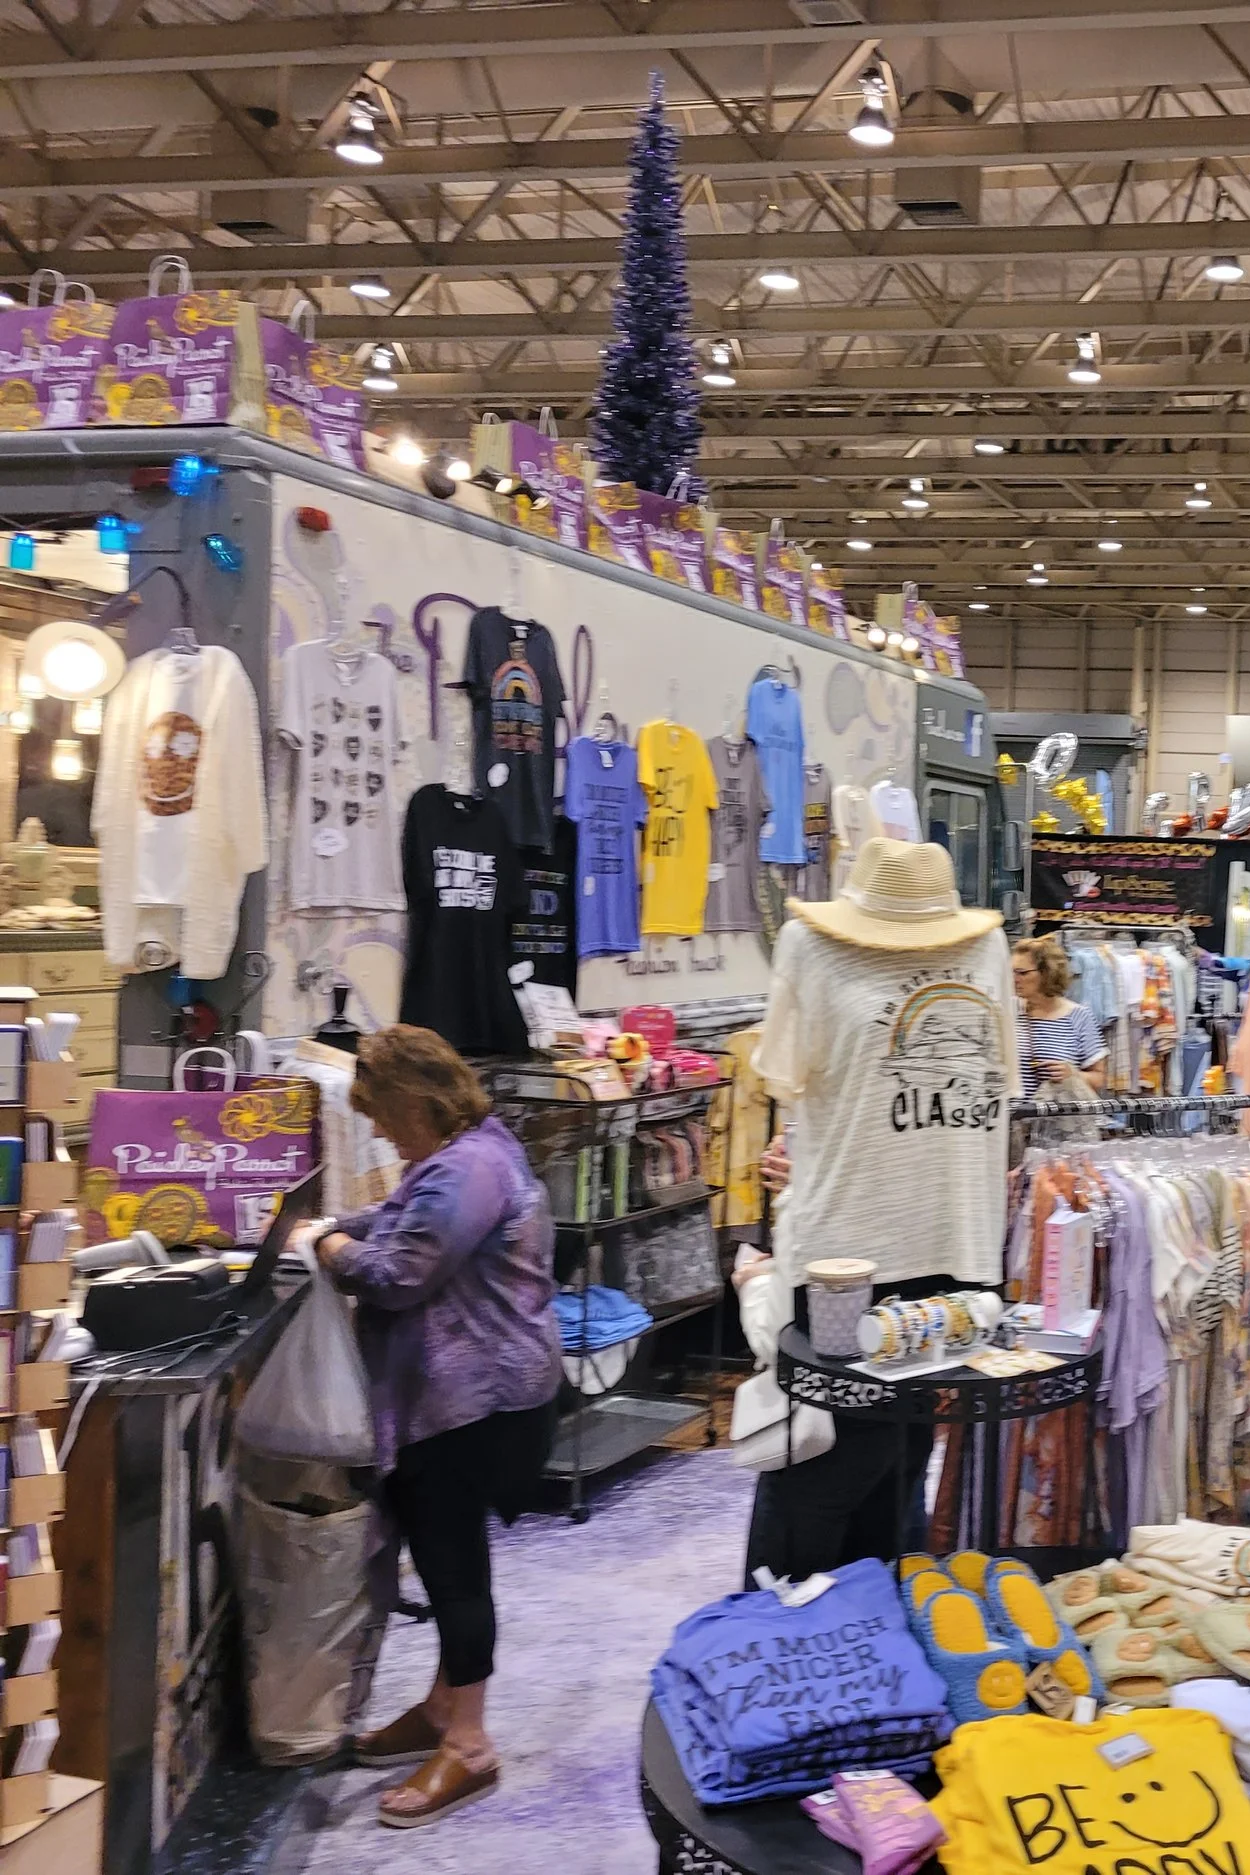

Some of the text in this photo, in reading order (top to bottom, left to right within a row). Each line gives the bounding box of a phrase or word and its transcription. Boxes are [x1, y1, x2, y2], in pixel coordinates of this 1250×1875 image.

[771, 1615, 888, 1658] MUCH
[763, 1642, 885, 1687] NICER
[1005, 1783, 1107, 1865] BE
